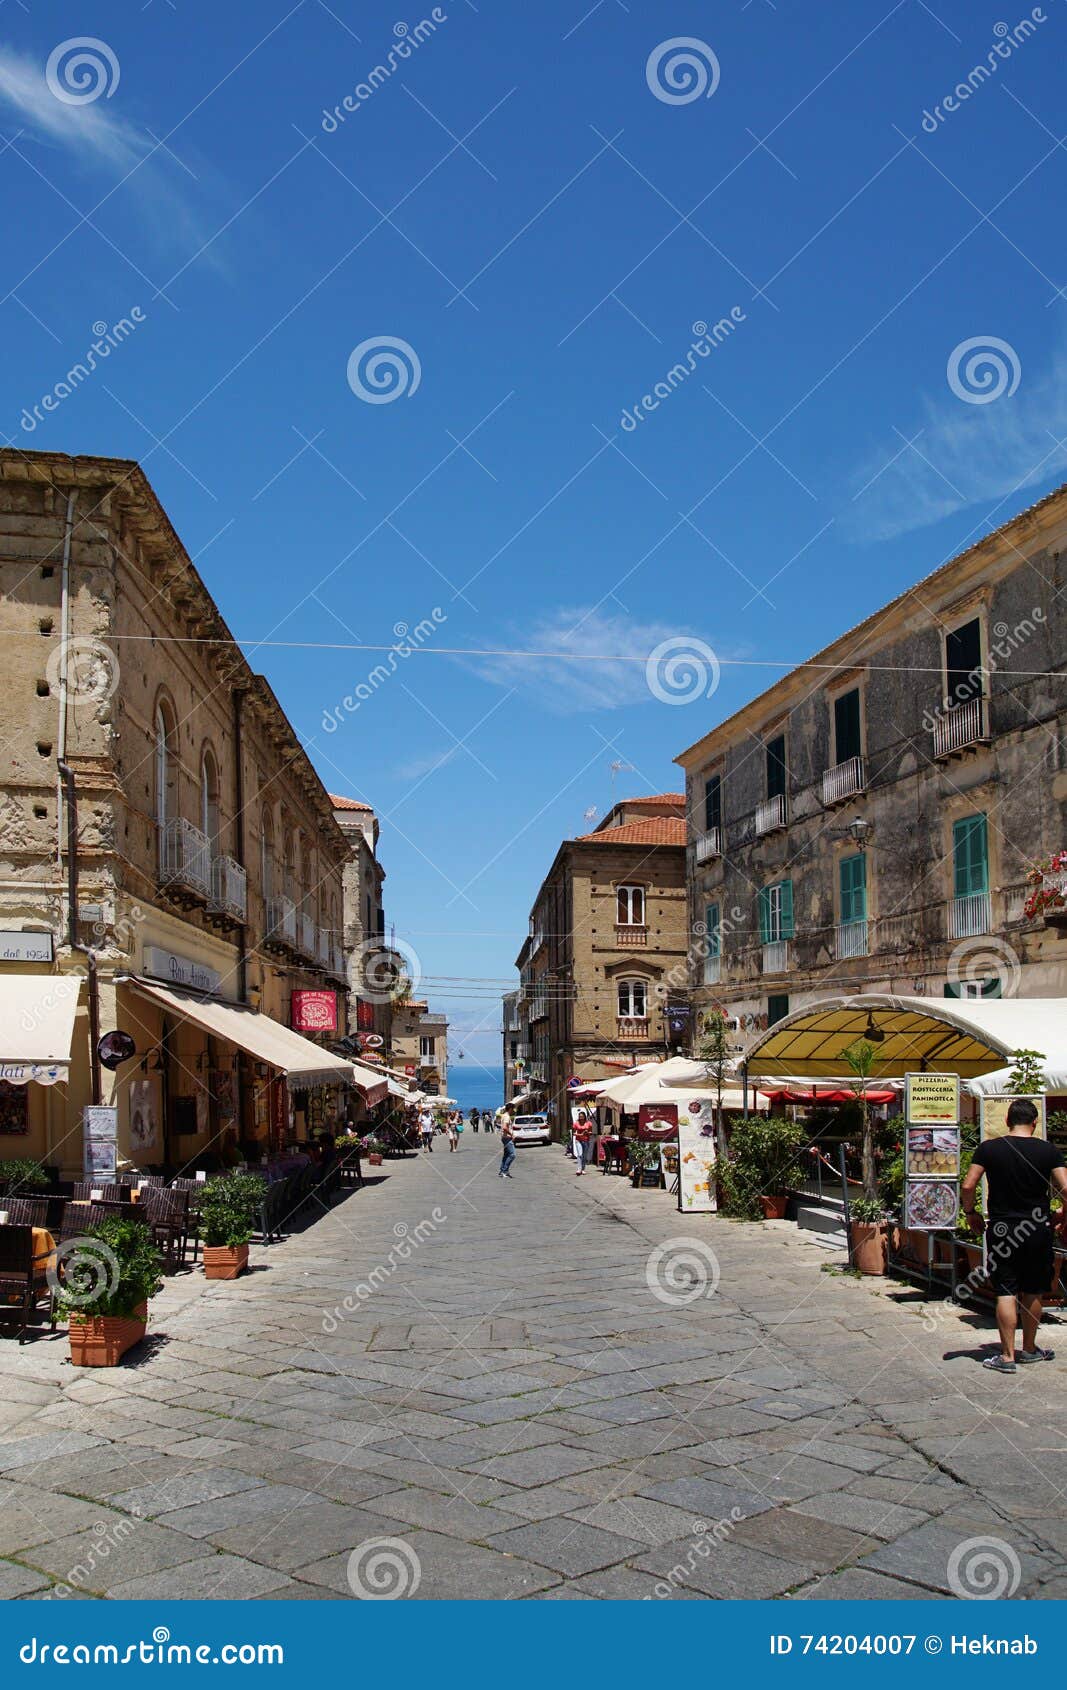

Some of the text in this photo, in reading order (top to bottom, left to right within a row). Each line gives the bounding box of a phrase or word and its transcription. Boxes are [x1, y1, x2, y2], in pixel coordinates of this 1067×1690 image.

[25, 949, 50, 960] 1954
[296, 1016, 333, 1029] La Napoli
